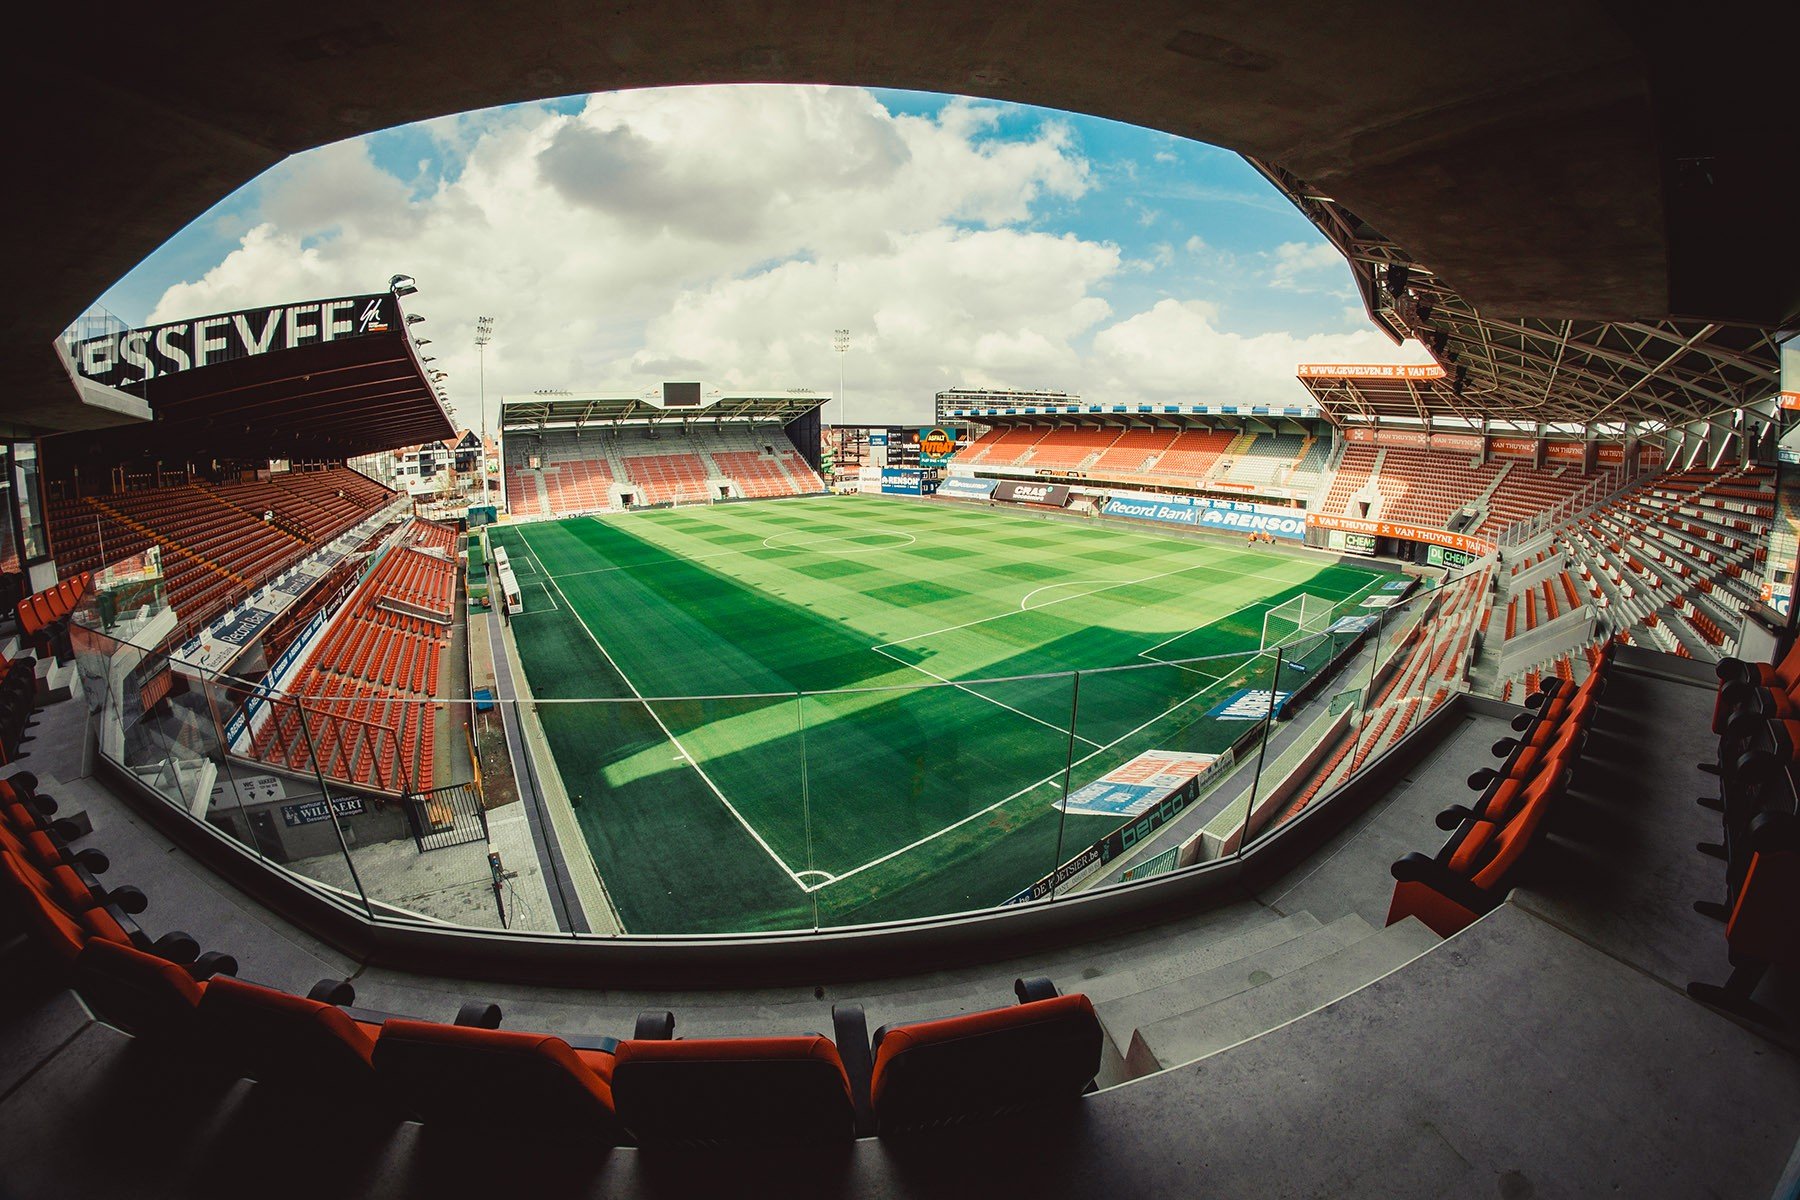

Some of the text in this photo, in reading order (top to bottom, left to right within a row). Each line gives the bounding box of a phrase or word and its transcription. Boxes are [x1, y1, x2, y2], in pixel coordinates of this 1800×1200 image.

[1309, 366, 1393, 376] WWW.GEWELVEN.BE
[1408, 367, 1425, 376] VAN
[921, 441, 955, 453] TUTGAT
[1505, 442, 1531, 451] THUYNE
[1108, 501, 1158, 517] Record
[1157, 506, 1195, 521] Bank
[1319, 517, 1379, 532] VAN THUYNE
[1394, 527, 1453, 544] VAN THUYNE
[221, 621, 252, 644] Record
[248, 610, 271, 627] Bank
[306, 814, 331, 823] Desselge
[1121, 793, 1184, 850] berto
[1033, 884, 1047, 899] DE
